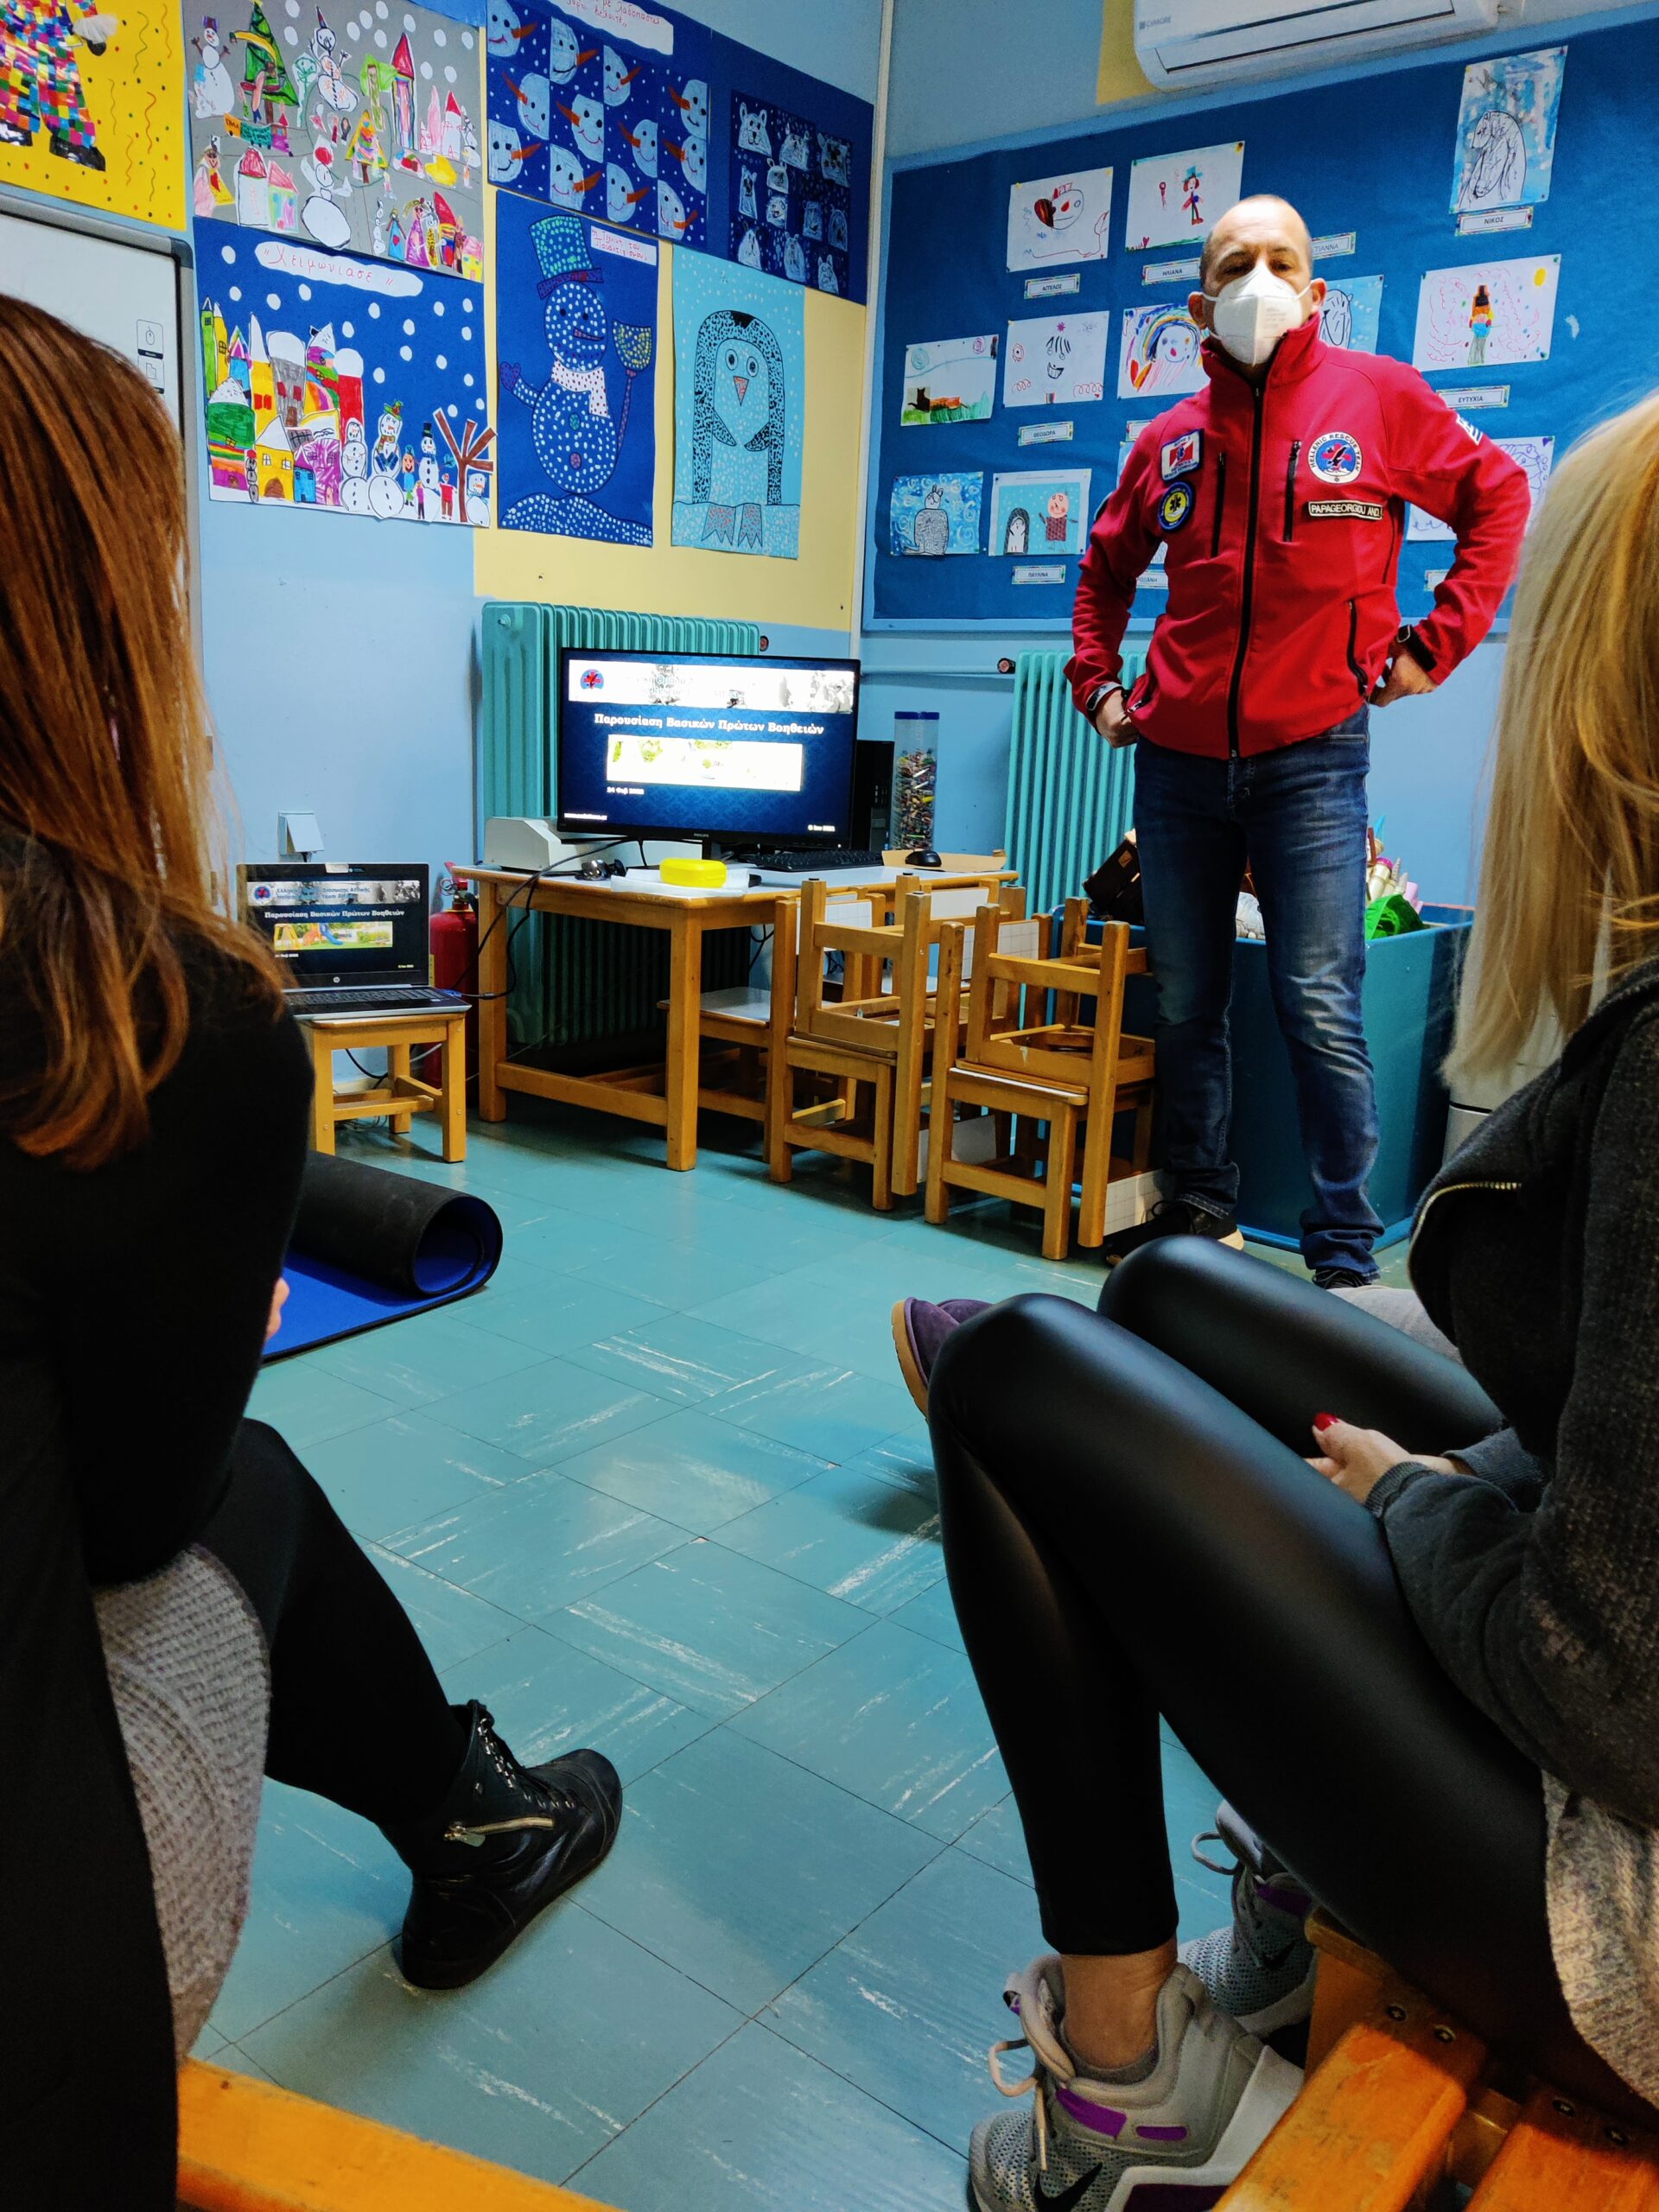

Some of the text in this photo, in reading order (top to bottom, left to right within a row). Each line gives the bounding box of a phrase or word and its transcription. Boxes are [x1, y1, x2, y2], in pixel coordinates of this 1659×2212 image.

[1484, 216, 1504, 225] ΝΙΚΟΣ
[1313, 243, 1339, 252] ΤΙΑΝΝΑ
[1309, 436, 1327, 468] HELLENIC
[1329, 434, 1357, 449] RESCUE
[594, 713, 824, 735] Παρουσίαση Βασικών Πρώτων Βοηθειών
[264, 911, 308, 919] Παρουσίαση
[372, 909, 405, 918] Βοηθειών
